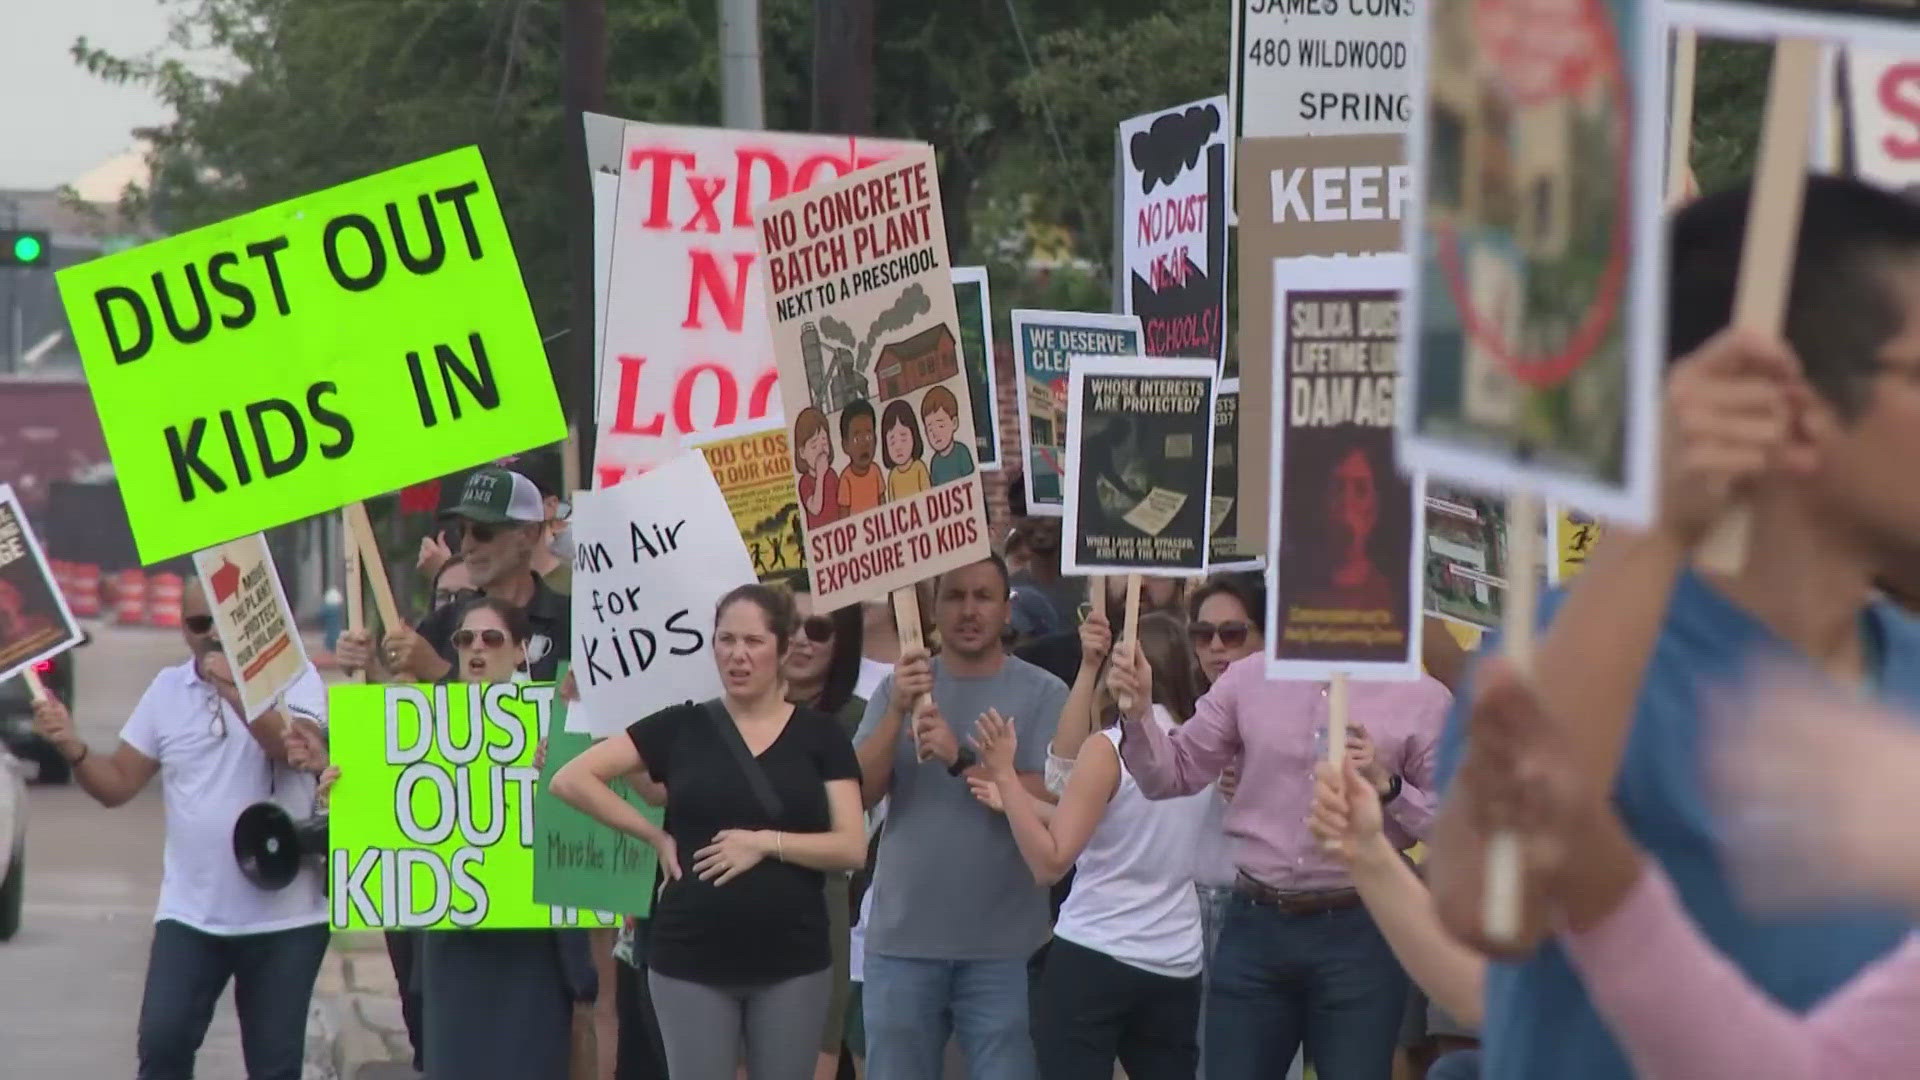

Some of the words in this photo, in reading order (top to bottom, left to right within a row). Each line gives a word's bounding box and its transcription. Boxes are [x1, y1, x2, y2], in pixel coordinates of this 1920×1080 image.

[1249, 37, 1291, 67] 480
[1299, 38, 1407, 69] WILDWOOD
[627, 142, 885, 236] TxD
[762, 209, 797, 254] NO
[803, 162, 930, 240] CONCRETE
[1138, 203, 1162, 248] NO
[1164, 194, 1209, 241] DUST
[94, 236, 291, 366] DUST
[322, 181, 485, 292] OUT
[769, 233, 848, 295] BATCH
[853, 204, 931, 265] PLANT
[1150, 246, 1194, 291] NEAR
[776, 289, 813, 323] NEXT
[816, 282, 836, 308] TO
[840, 277, 851, 301] A
[852, 246, 939, 296] PRESCHOOL
[1029, 328, 1056, 349] WE
[1060, 331, 1127, 353] DESERVE
[1146, 303, 1220, 357] SCHOOLS!
[1091, 378, 1137, 396] WHOSE
[1140, 379, 1205, 397] INTERESTS
[1094, 394, 1120, 412] ARE
[1123, 395, 1200, 414] PROTECTED?
[164, 380, 355, 503] KIDS
[405, 332, 501, 429] IN
[703, 444, 737, 467] OO
[728, 465, 760, 484] OUR
[630, 519, 686, 564] Air
[811, 523, 857, 563] STOP
[863, 501, 922, 546] SILICA
[926, 481, 974, 524] DUST
[1085, 536, 1111, 548] WHEN
[1112, 537, 1134, 549] LAWS
[1137, 538, 1152, 549] ARE
[816, 541, 905, 596] EXPOSURE
[907, 532, 932, 564] TO
[936, 517, 978, 555] KIDS
[1096, 548, 1117, 560] KIDS
[1119, 550, 1135, 560] PAY
[1138, 550, 1154, 561] THE
[1156, 550, 1182, 561] PRICE
[592, 586, 641, 623] for
[384, 683, 554, 766] DUST
[394, 761, 538, 848] OUT
[331, 845, 490, 929] KIDS
